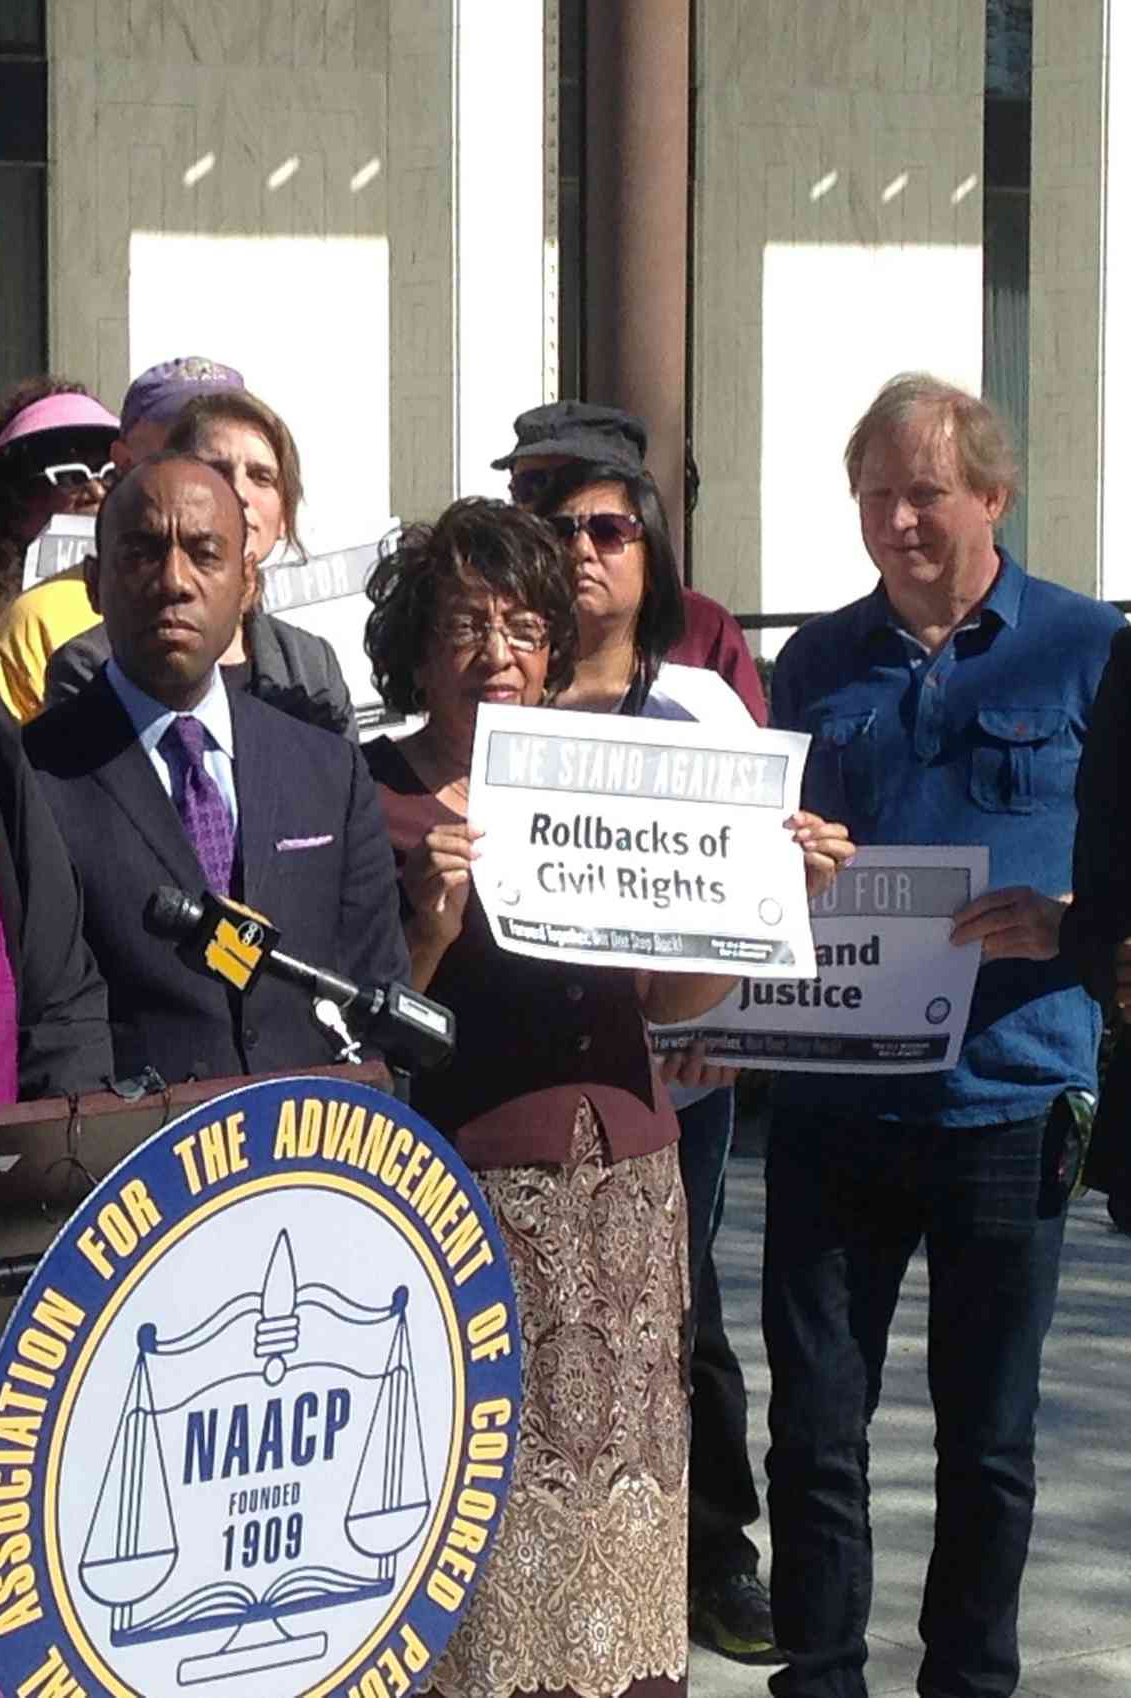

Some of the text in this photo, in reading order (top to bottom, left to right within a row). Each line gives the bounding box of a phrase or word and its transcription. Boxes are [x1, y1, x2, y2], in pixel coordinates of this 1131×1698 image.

[508, 738, 768, 796] WE STAND AGAINST
[530, 812, 732, 858] Rollbacks of
[537, 861, 727, 909] Civil Rights
[855, 872, 912, 911] FOR
[816, 935, 880, 966] and
[739, 977, 863, 1011] Justice
[173, 1111, 249, 1196] THE
[274, 1098, 495, 1286] ADVANCEMENT
[77, 1178, 164, 1279] FOR
[467, 1302, 511, 1363] OF
[182, 1387, 352, 1486] NAACP
[227, 1481, 302, 1517] FOUNDED
[426, 1398, 512, 1612] COLORED
[221, 1512, 304, 1572] 1909
